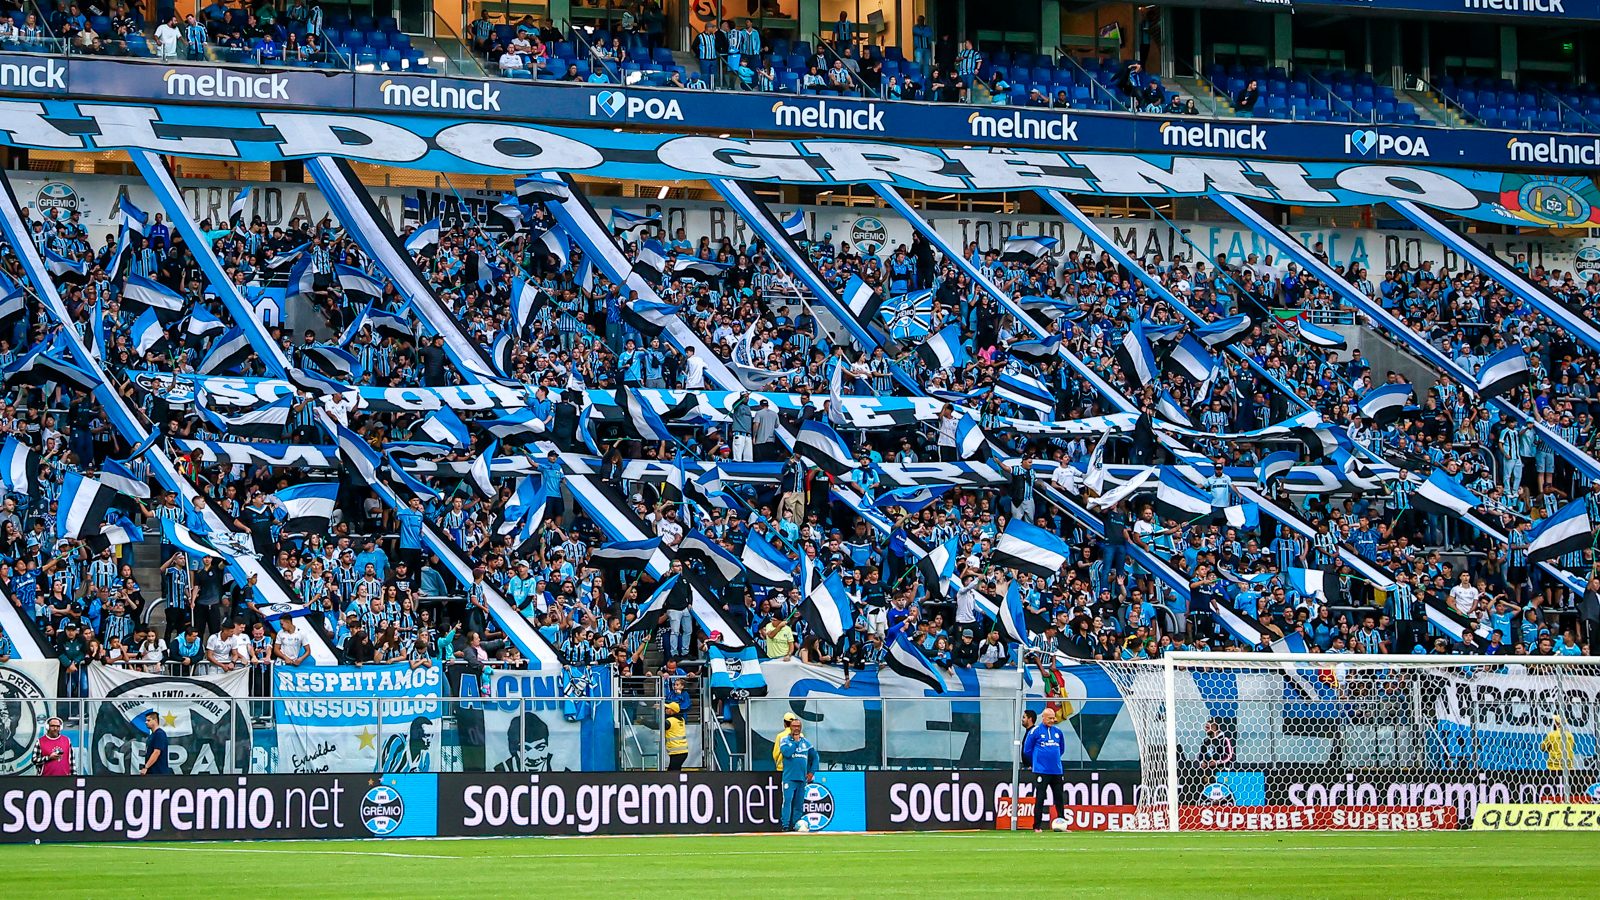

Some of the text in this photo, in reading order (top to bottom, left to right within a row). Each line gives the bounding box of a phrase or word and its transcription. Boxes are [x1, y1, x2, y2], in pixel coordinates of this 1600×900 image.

[165, 69, 290, 100] melnick
[383, 80, 501, 112] melnick
[627, 98, 684, 120] POA
[775, 101, 885, 131] melnick
[970, 111, 1078, 142] melnick
[1163, 122, 1267, 151] melnick
[1379, 134, 1430, 157] POA
[656, 135, 1479, 210] GRÊMIO
[166, 186, 314, 227] ORCIDA
[853, 230, 885, 241] GRÊMIO
[1114, 225, 1194, 264] MAIS
[1385, 235, 1423, 272] DO
[277, 666, 440, 693] RESPEITAMOS
[284, 697, 371, 718] NOSSOS
[3, 777, 344, 839] socio.gremio.net
[363, 803, 401, 816] GRÊMIO
[463, 773, 779, 834] socio.gremio.net
[803, 800, 832, 812] RÊMIO
[1064, 810, 1172, 829] SUPERBE
[1201, 808, 1446, 830] SUPERBET SUPERBET
